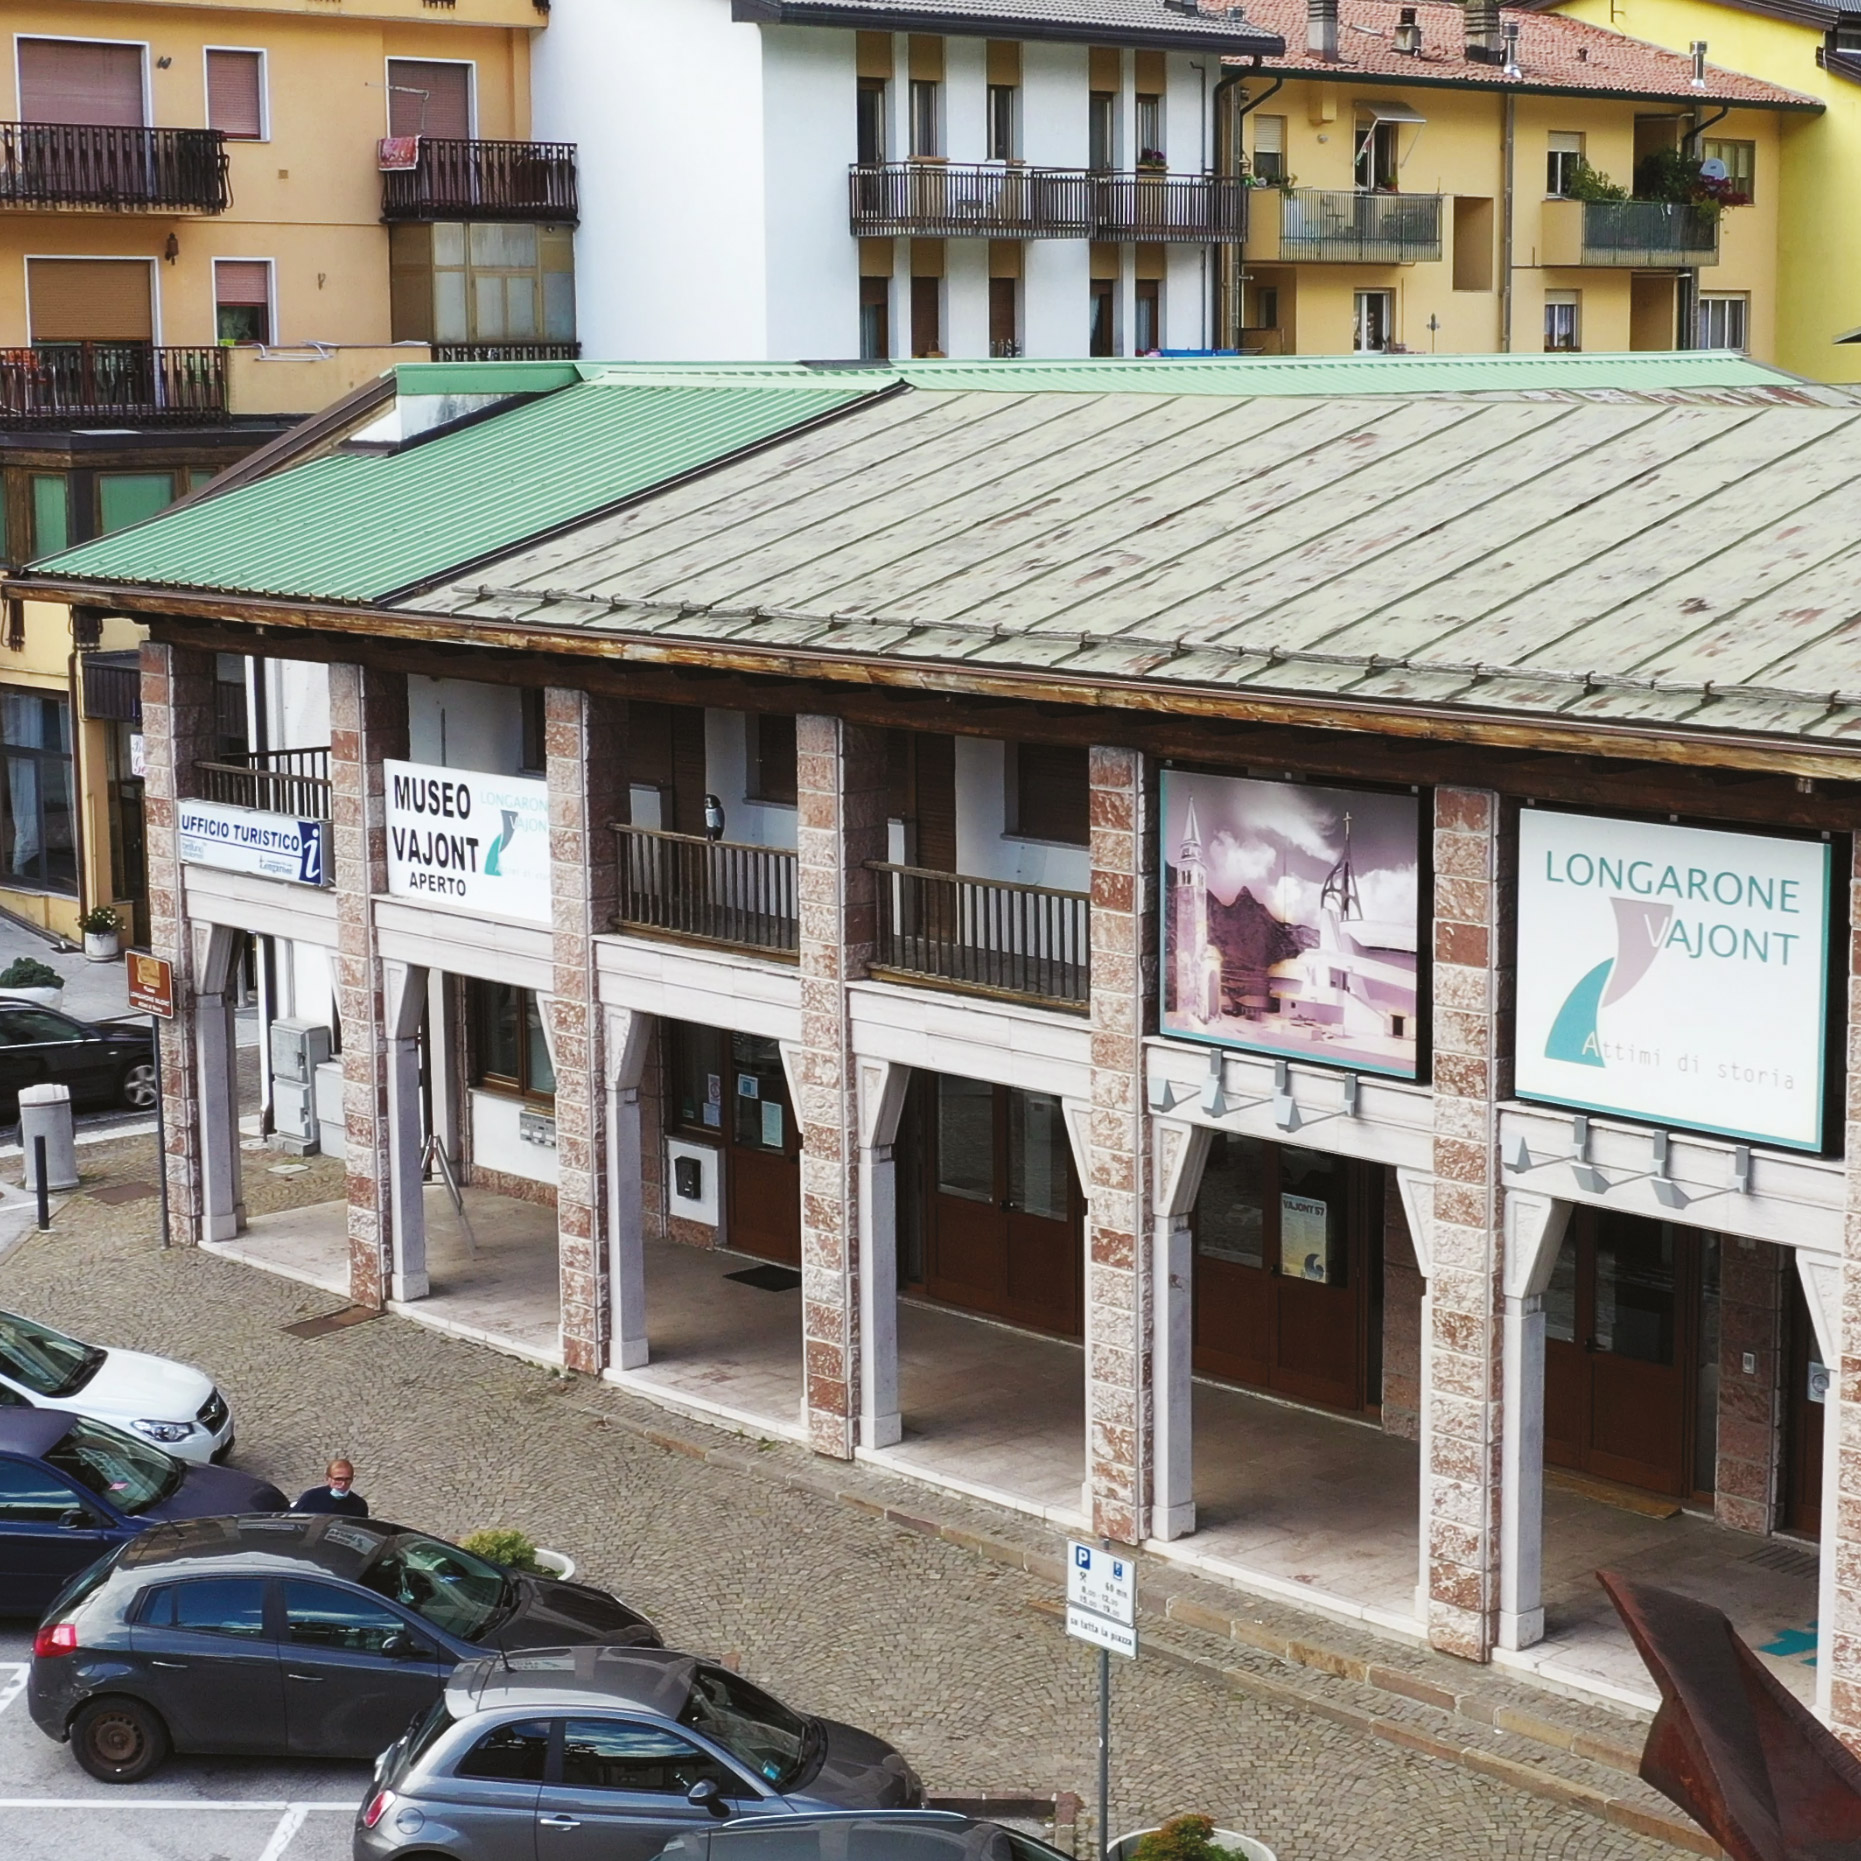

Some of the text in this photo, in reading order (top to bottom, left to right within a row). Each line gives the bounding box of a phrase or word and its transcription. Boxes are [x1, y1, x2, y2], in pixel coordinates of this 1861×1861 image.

[394, 774, 471, 820] MUSEO
[480, 791, 548, 812] LONGARON
[181, 814, 300, 852] UFFICIO TURISTICO
[509, 815, 548, 833] VAJON
[391, 826, 479, 873] VAJONT
[409, 872, 467, 897] APERTO
[1546, 850, 1800, 914] LONGARONE
[1643, 913, 1800, 966] VAJONT
[1581, 1031, 1794, 1090] Attimi di storia
[1079, 1547, 1089, 1565] P
